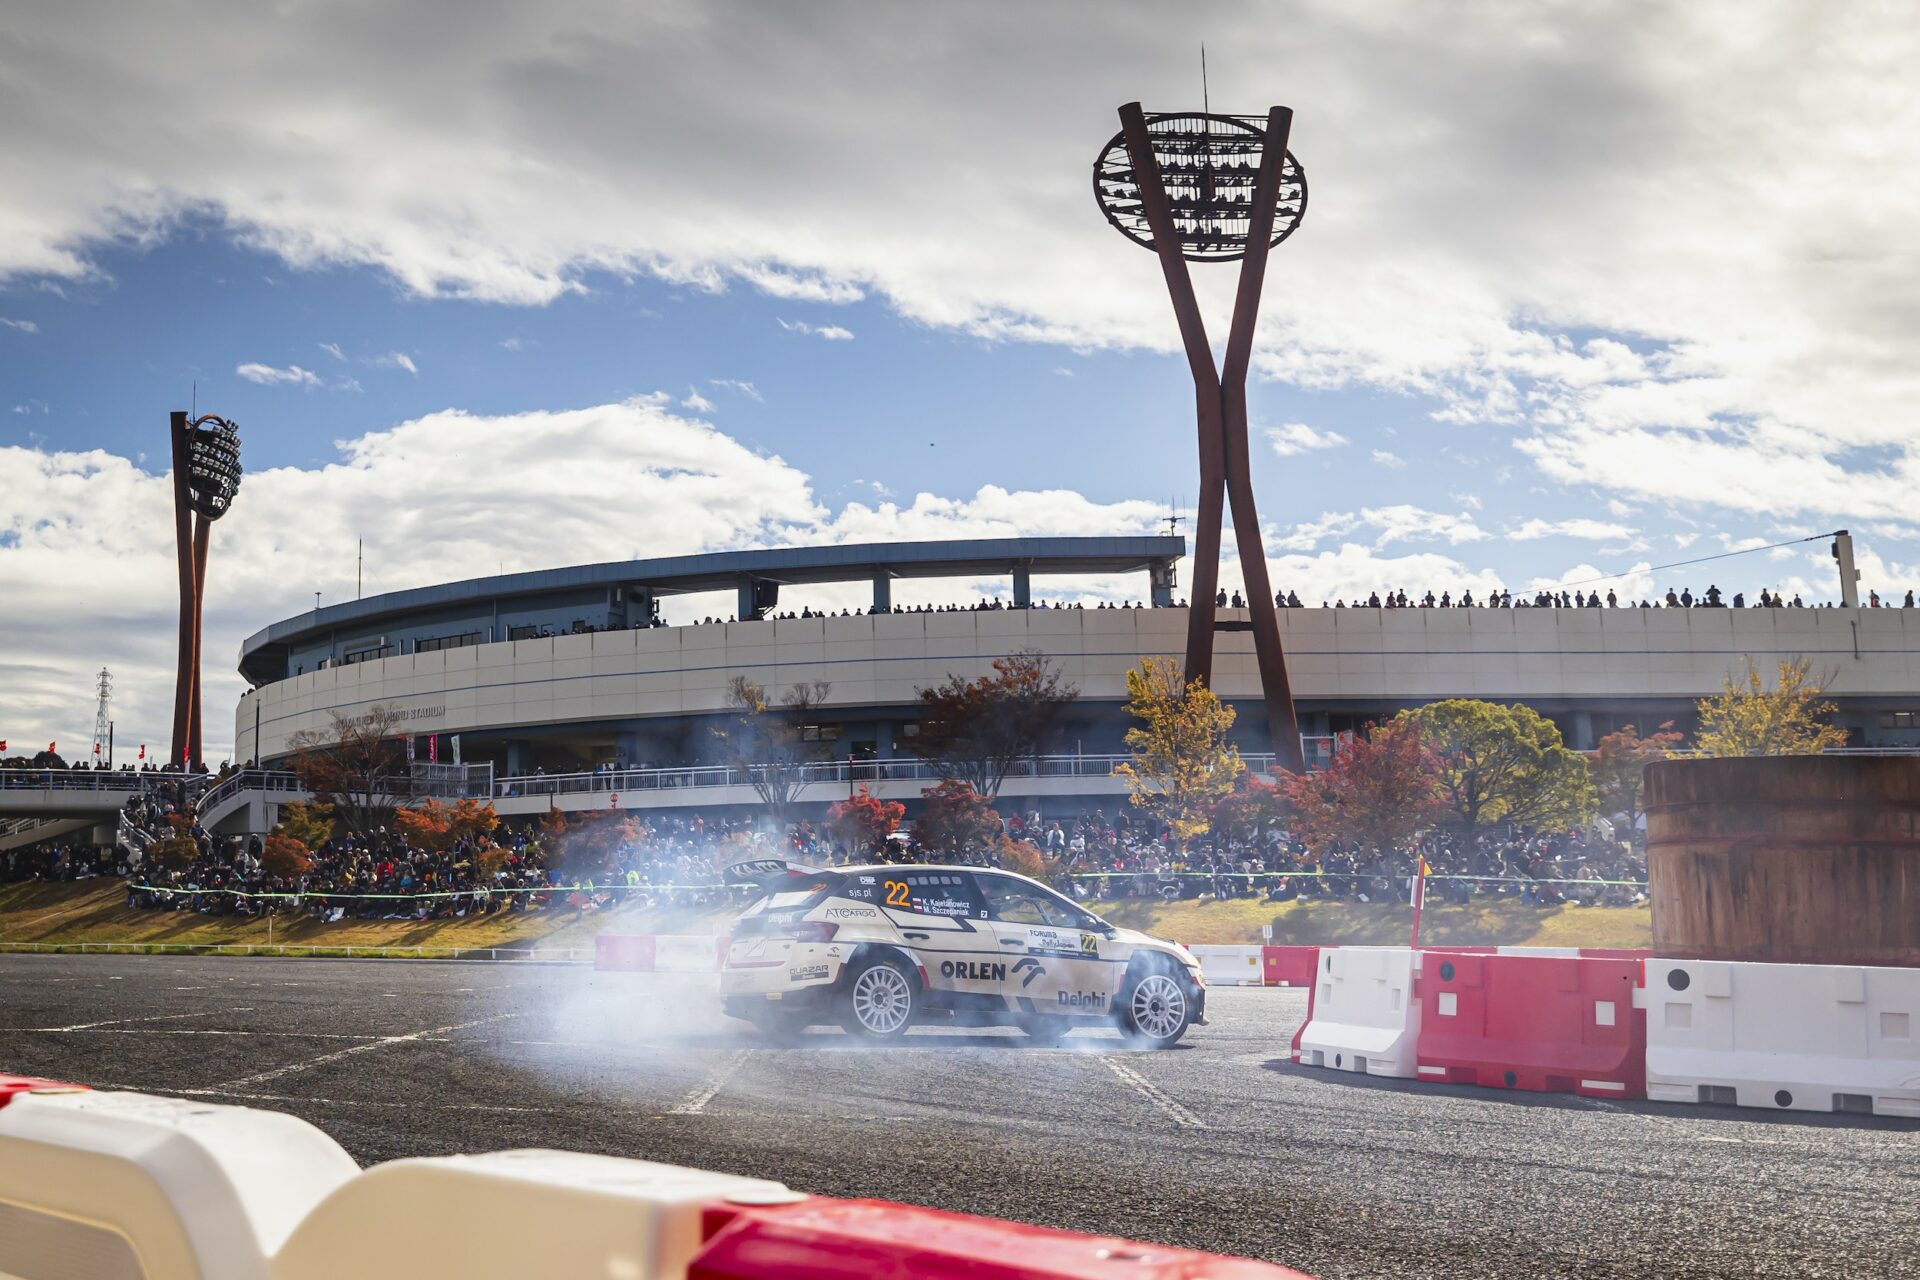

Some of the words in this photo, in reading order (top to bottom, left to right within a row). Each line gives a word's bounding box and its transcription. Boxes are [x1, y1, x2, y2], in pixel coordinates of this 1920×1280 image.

[884, 880, 910, 907] 22
[1081, 935, 1097, 953] 22
[940, 960, 1006, 981] ORLEN
[1057, 990, 1106, 1009] Delphi
